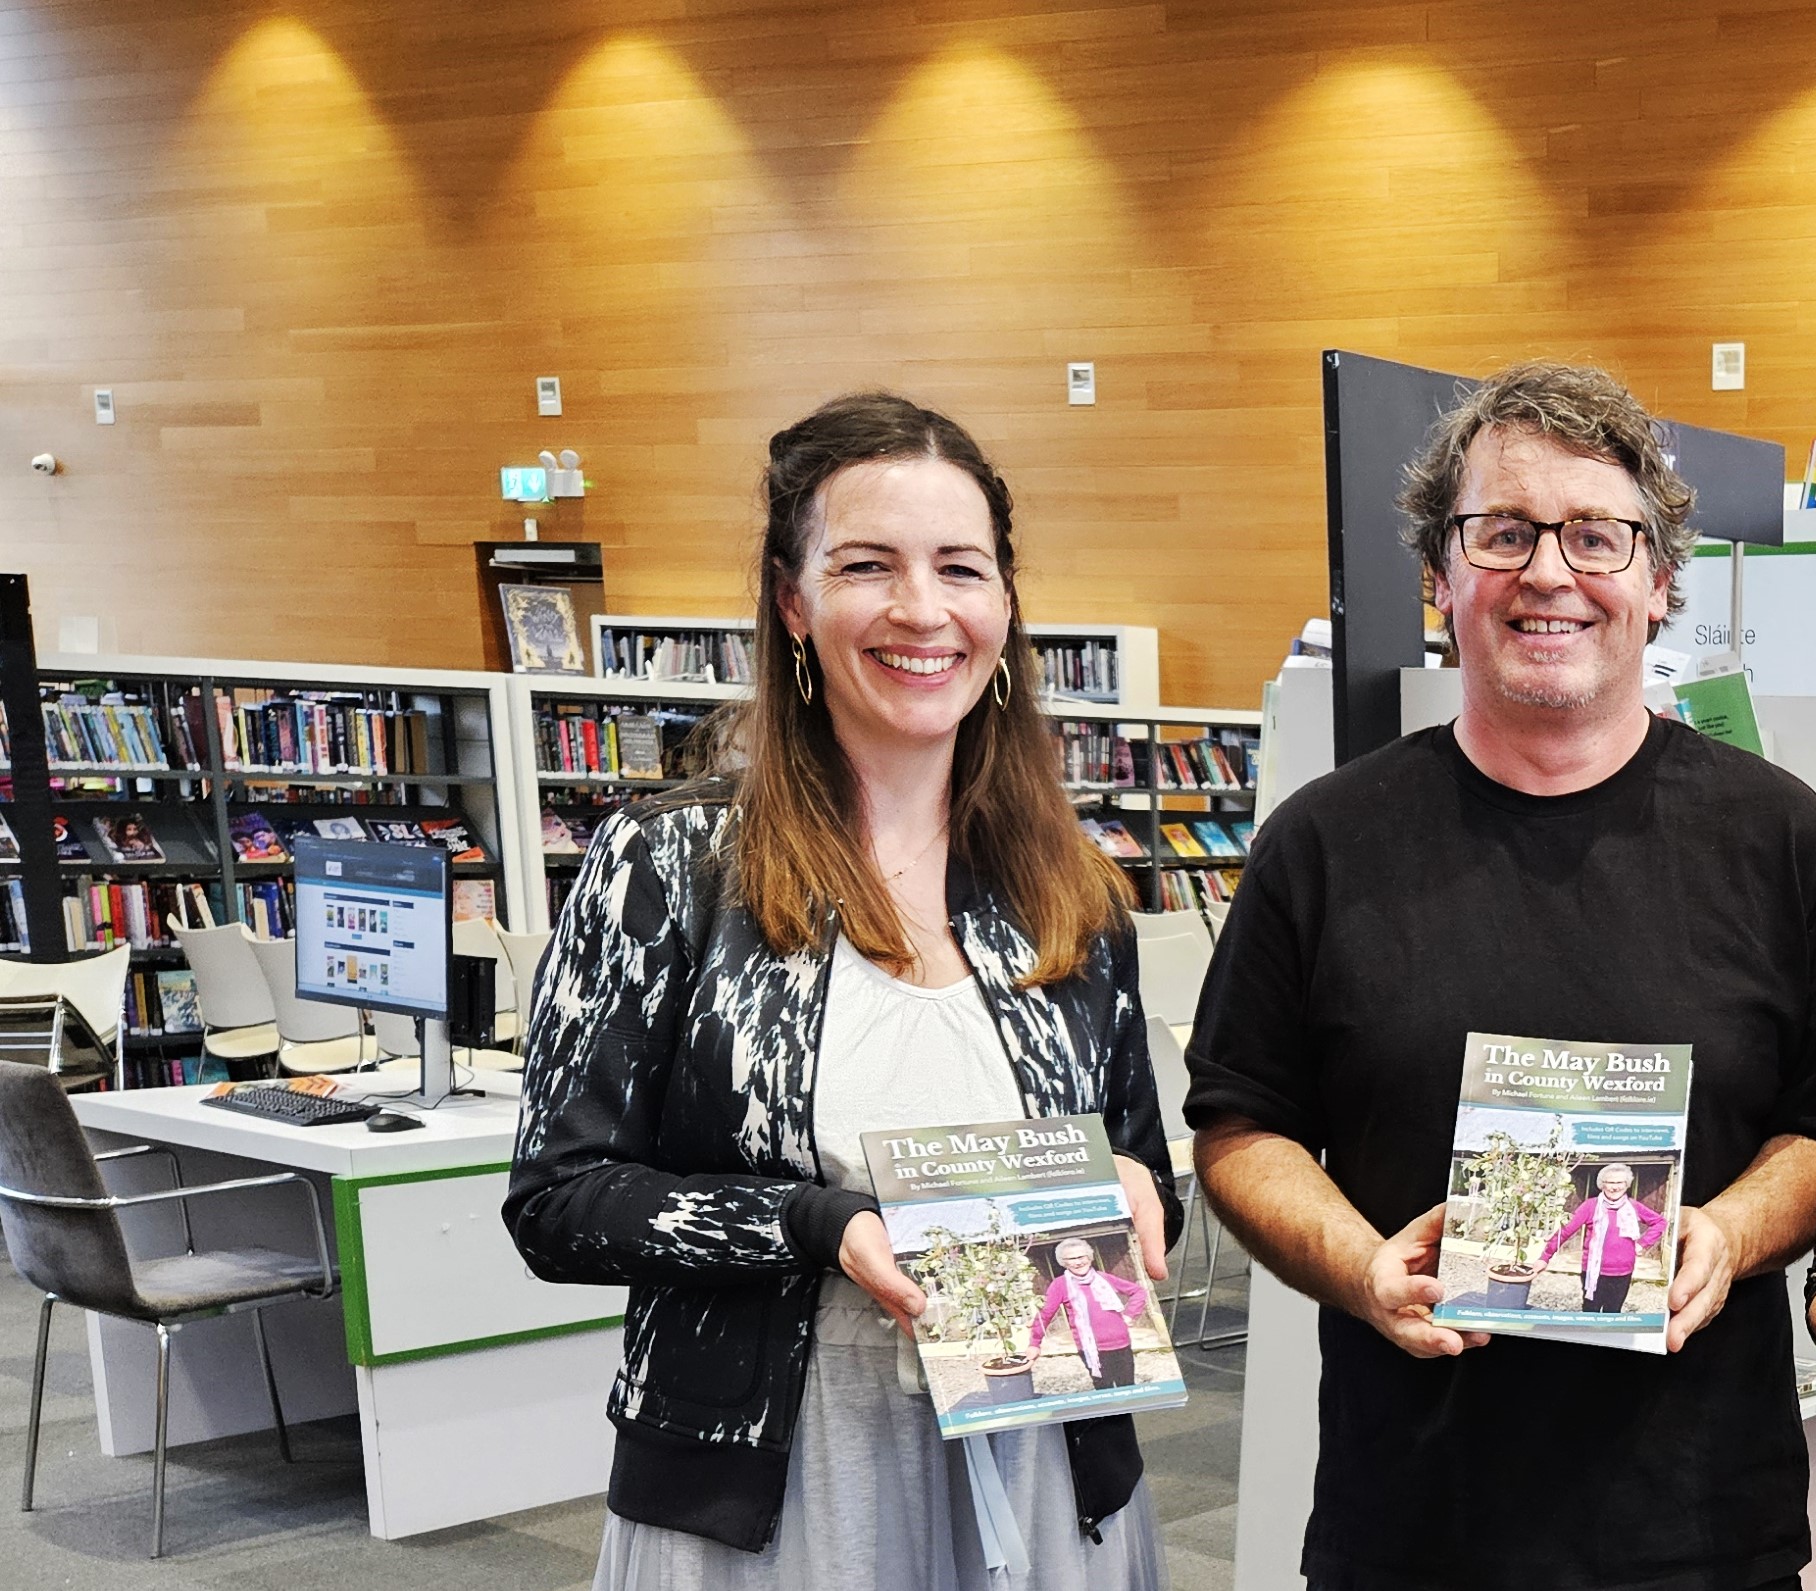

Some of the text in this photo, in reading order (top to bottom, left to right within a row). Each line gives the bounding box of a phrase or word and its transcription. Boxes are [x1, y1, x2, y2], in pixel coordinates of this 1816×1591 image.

[1694, 624, 1756, 645] Sláie
[1483, 1044, 1671, 1074] The May Bush
[1484, 1068, 1665, 1093] in County Wexford
[882, 1124, 1088, 1160] The May Bush
[895, 1147, 1089, 1179] in County Wexford
